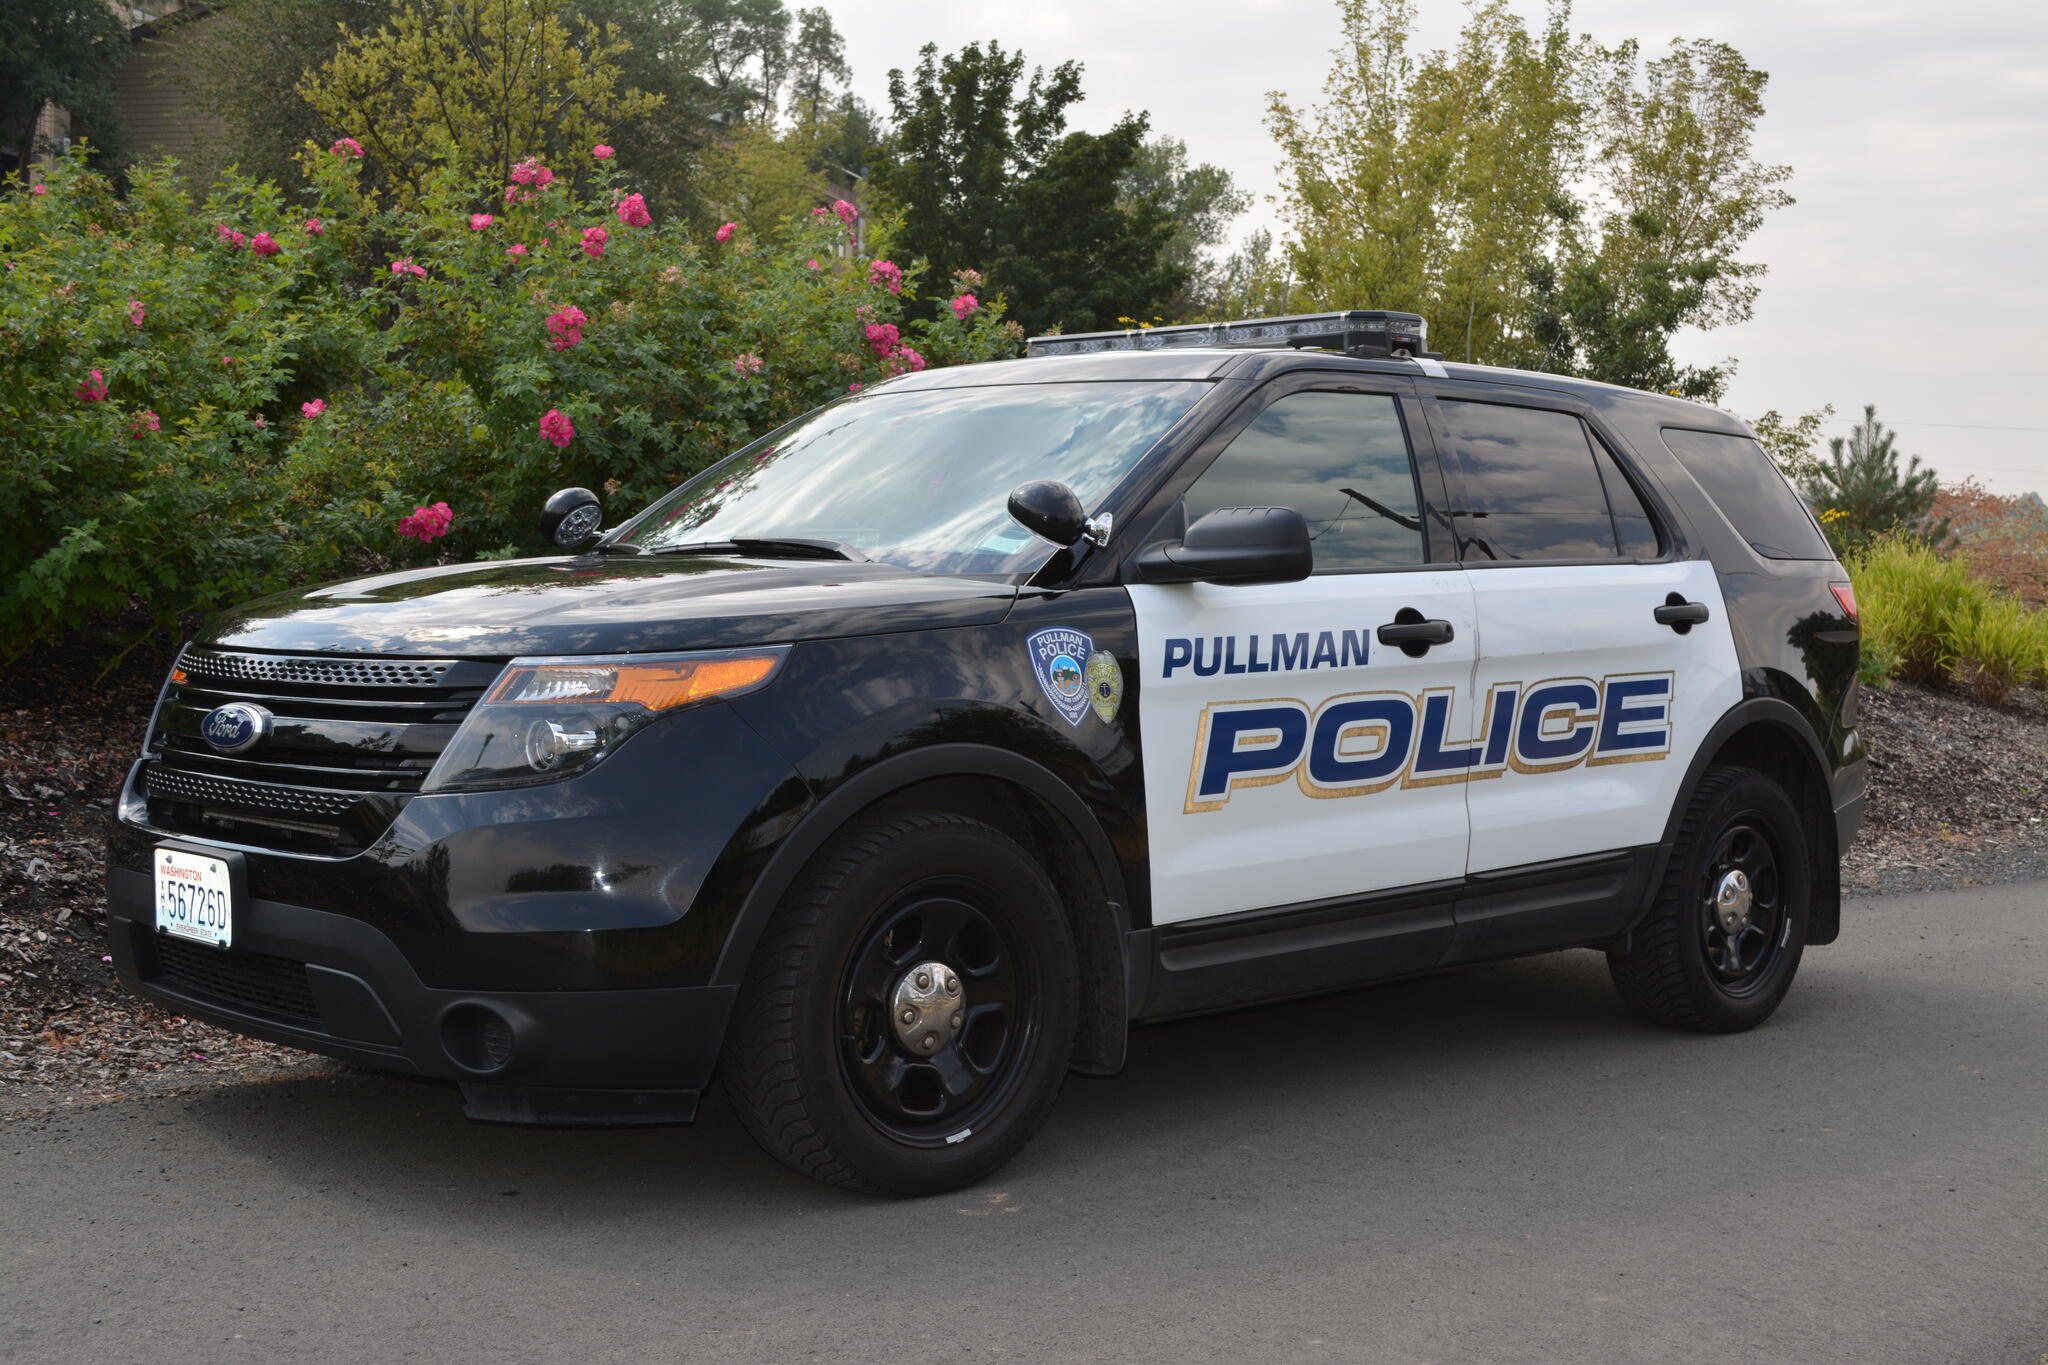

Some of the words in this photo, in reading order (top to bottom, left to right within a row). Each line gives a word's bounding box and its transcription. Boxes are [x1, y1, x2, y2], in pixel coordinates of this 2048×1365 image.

[1036, 632, 1083, 647] PULLMAN
[1039, 642, 1086, 660] POLICE
[1162, 629, 1371, 679] PULLMAN
[208, 710, 245, 739] Ford
[1183, 670, 1676, 815] POLICE
[160, 864, 203, 882] WASHINGTON
[168, 880, 227, 930] 56726D
